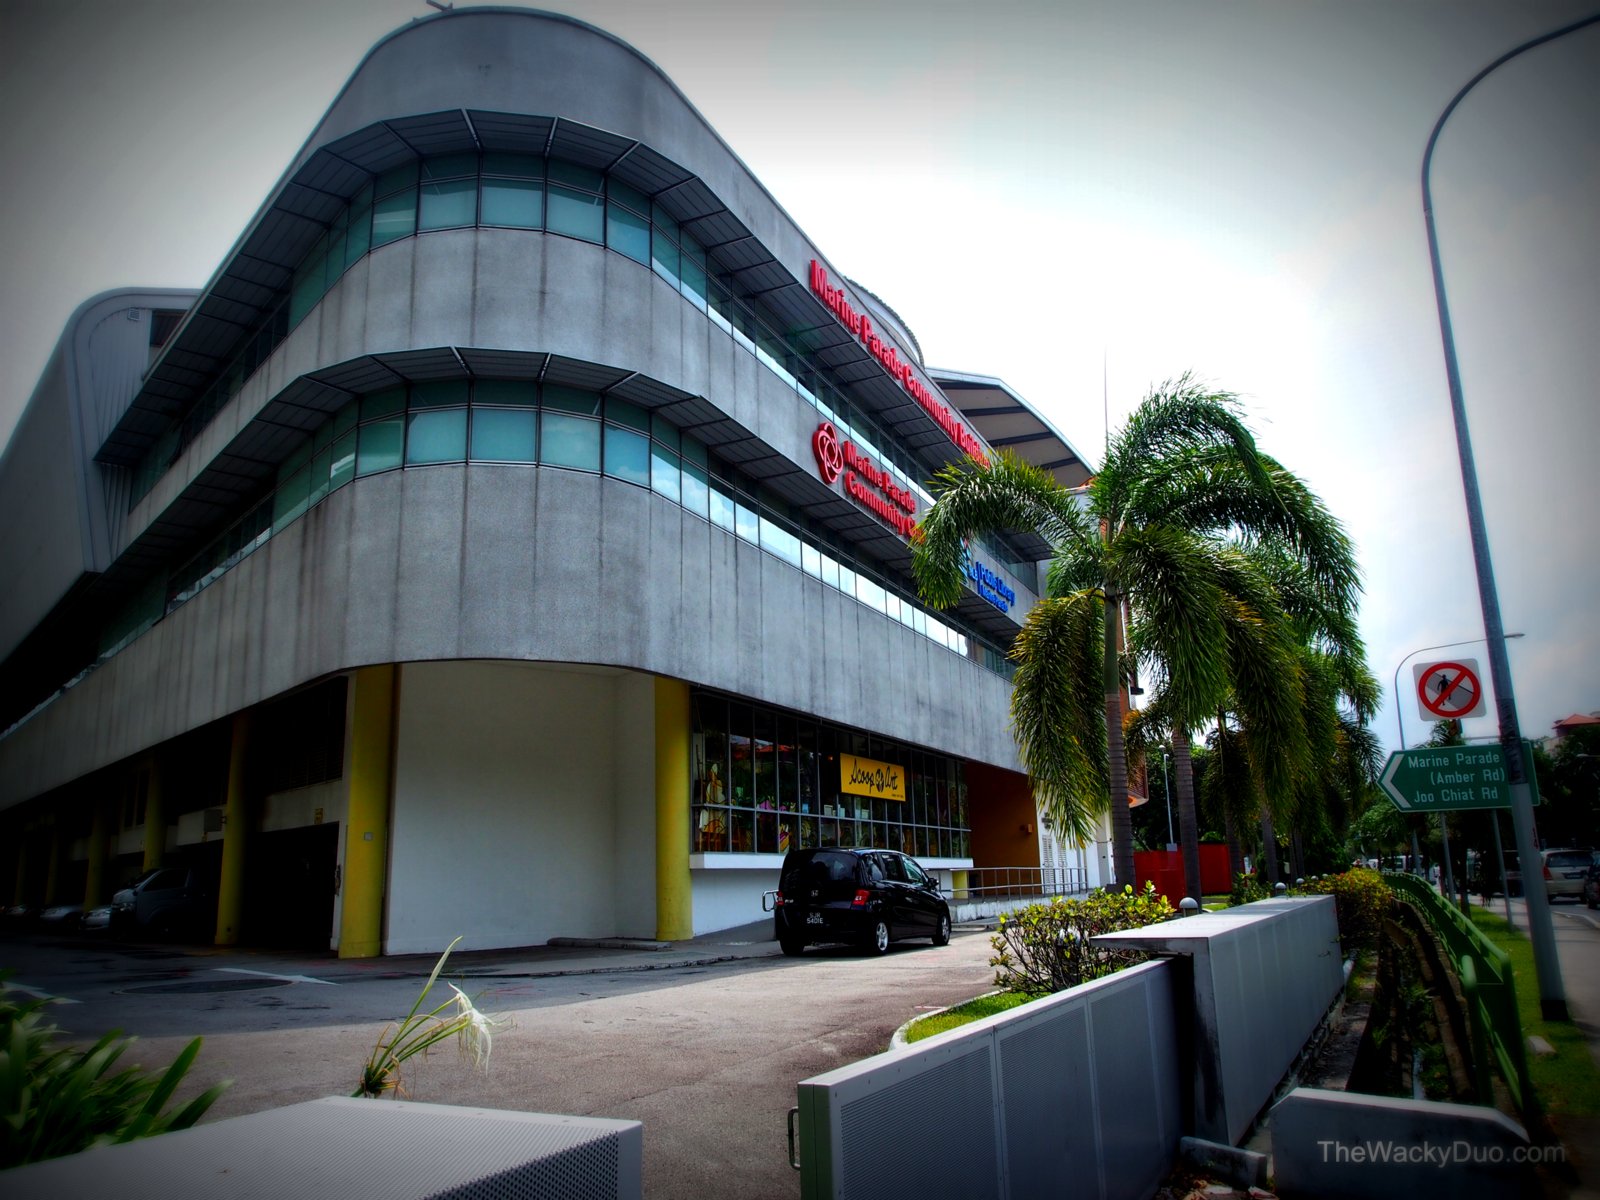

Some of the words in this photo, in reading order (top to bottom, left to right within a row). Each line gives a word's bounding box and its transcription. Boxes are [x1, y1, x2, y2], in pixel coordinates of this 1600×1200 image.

[810, 259, 861, 335] Marine
[861, 315, 904, 380] Parade
[902, 363, 957, 443] Community
[843, 440, 883, 488] Marine
[881, 471, 916, 514] Parade
[845, 470, 905, 536] Community
[1408, 754, 1449, 769] Marine
[1456, 752, 1500, 766] Parade
[1430, 771, 1476, 786] (Amber
[1483, 767, 1505, 782] Rd)
[1414, 790, 1435, 804] Joo
[1441, 788, 1474, 802] Chiat
[1482, 786, 1498, 801] Rd
